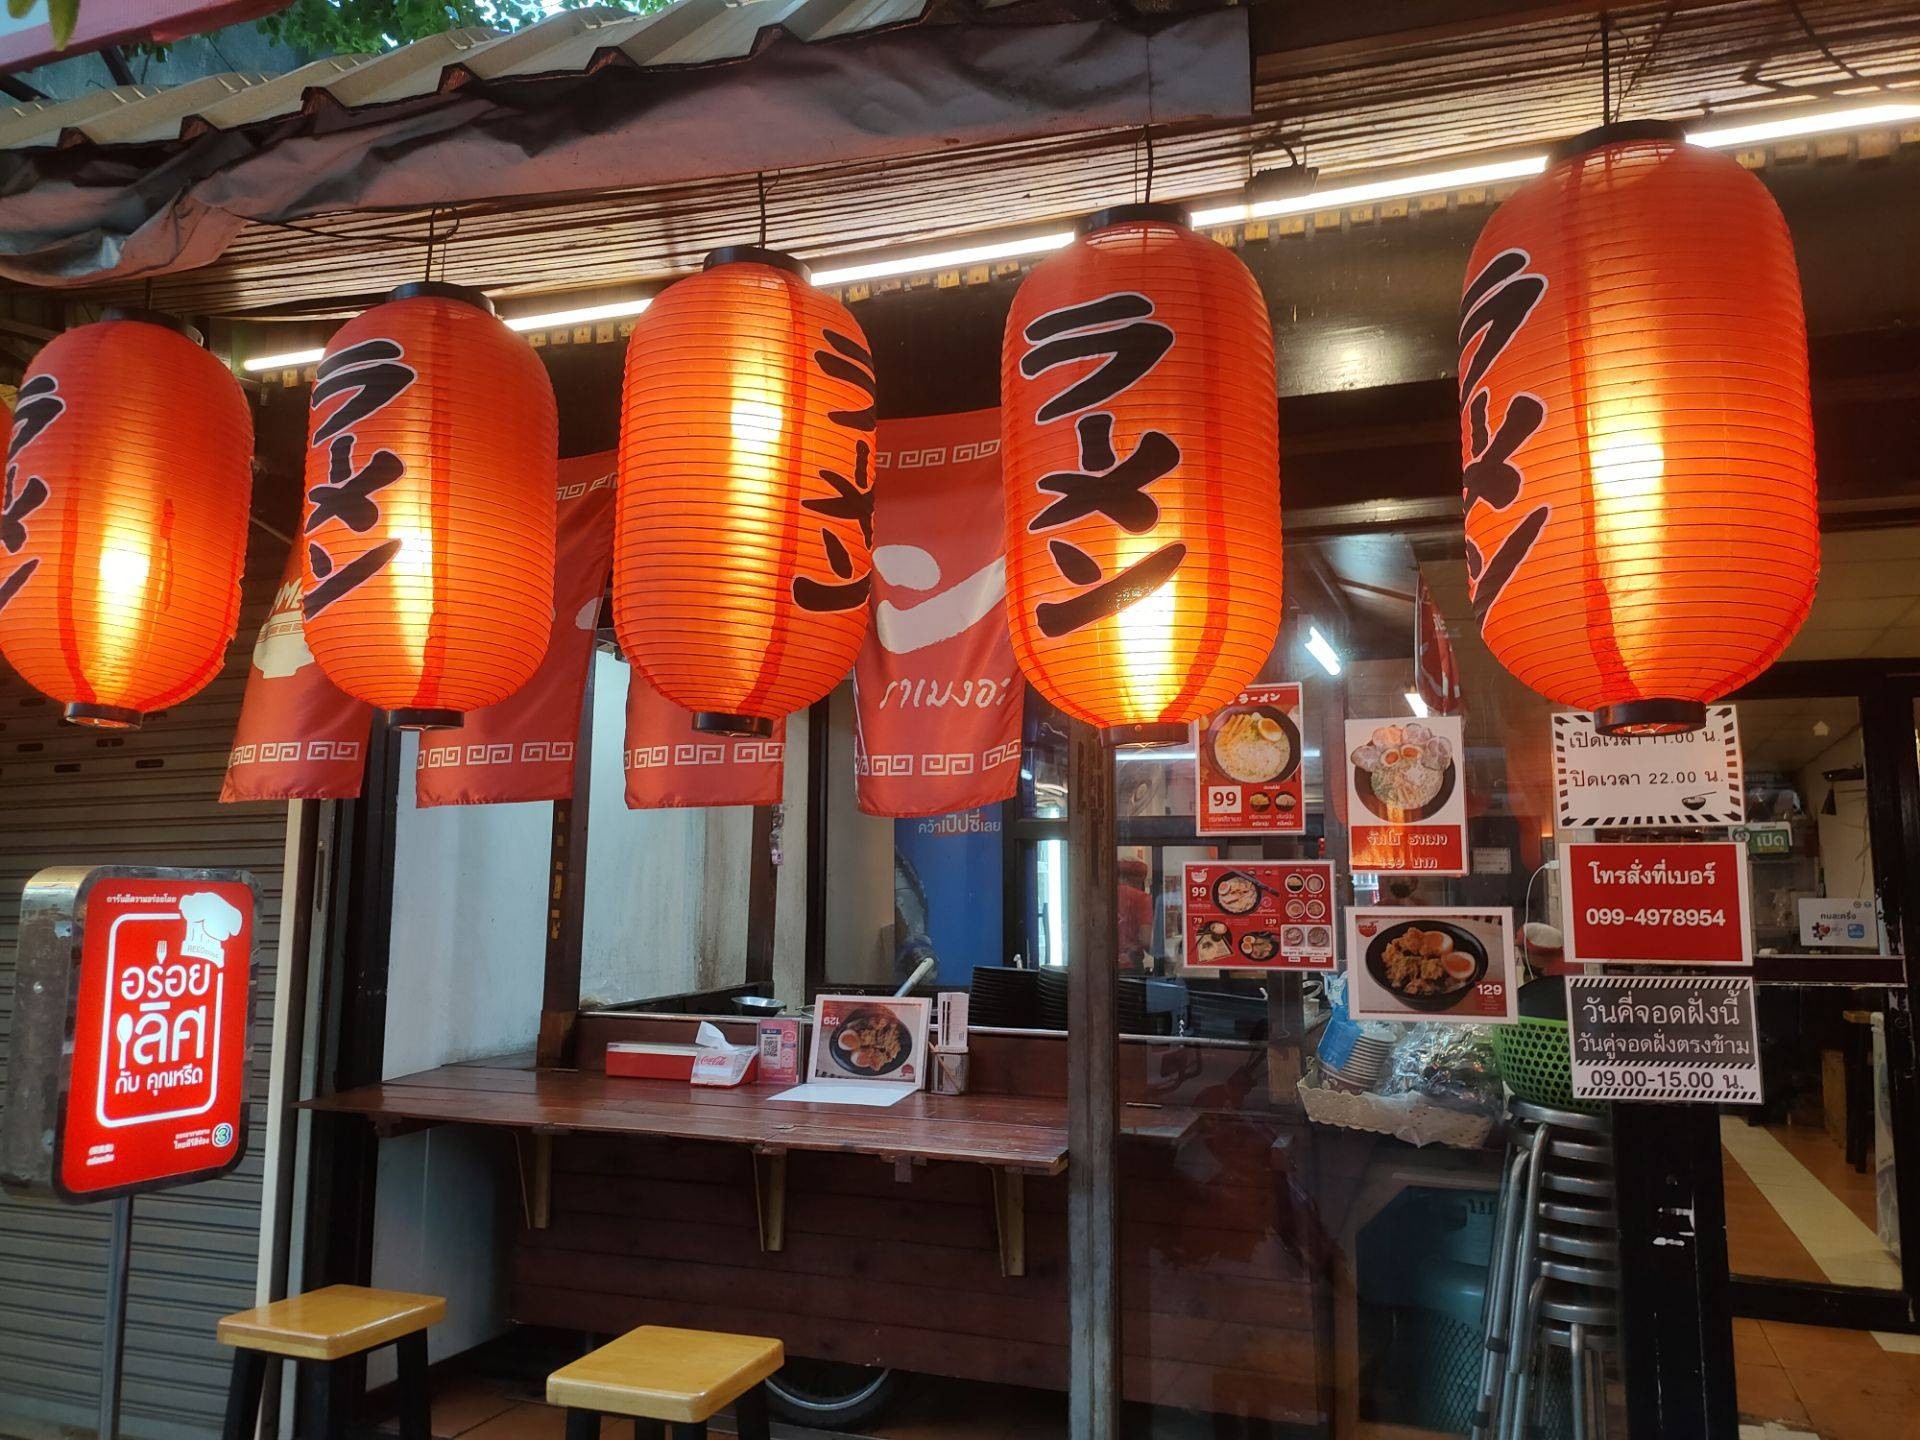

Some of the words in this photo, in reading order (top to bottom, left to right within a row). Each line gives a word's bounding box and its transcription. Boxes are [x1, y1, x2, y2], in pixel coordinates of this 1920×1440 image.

[1019, 291, 1188, 637] ラーメン
[304, 338, 417, 621] ラーメン
[1702, 729, 1721, 743] น.
[1570, 770, 1641, 787] ปิดเวลา
[1648, 771, 1697, 785] 22.00
[1704, 770, 1724, 783] น.
[1213, 791, 1237, 807] 99
[1757, 832, 1785, 847] เปิด
[1588, 858, 1717, 885] โทรสั่งที่เบอร์
[1191, 886, 1207, 897] 99
[1586, 908, 1726, 926] 099-4978954
[120, 945, 210, 1000] อร่อย
[1477, 984, 1502, 996] 129
[1582, 989, 1740, 1025] วันคี่จอดฝั่งนี้
[823, 1015, 841, 1025] 129
[116, 1001, 208, 1069] เลิศ
[1577, 1029, 1750, 1060] วันคู่จอดฝั่งตรงข้าม
[115, 1072, 140, 1095] กับ
[147, 1063, 203, 1096] คุณหรีด
[1590, 1070, 1714, 1088] 09.00-15.00
[1722, 1074, 1745, 1090] น.
